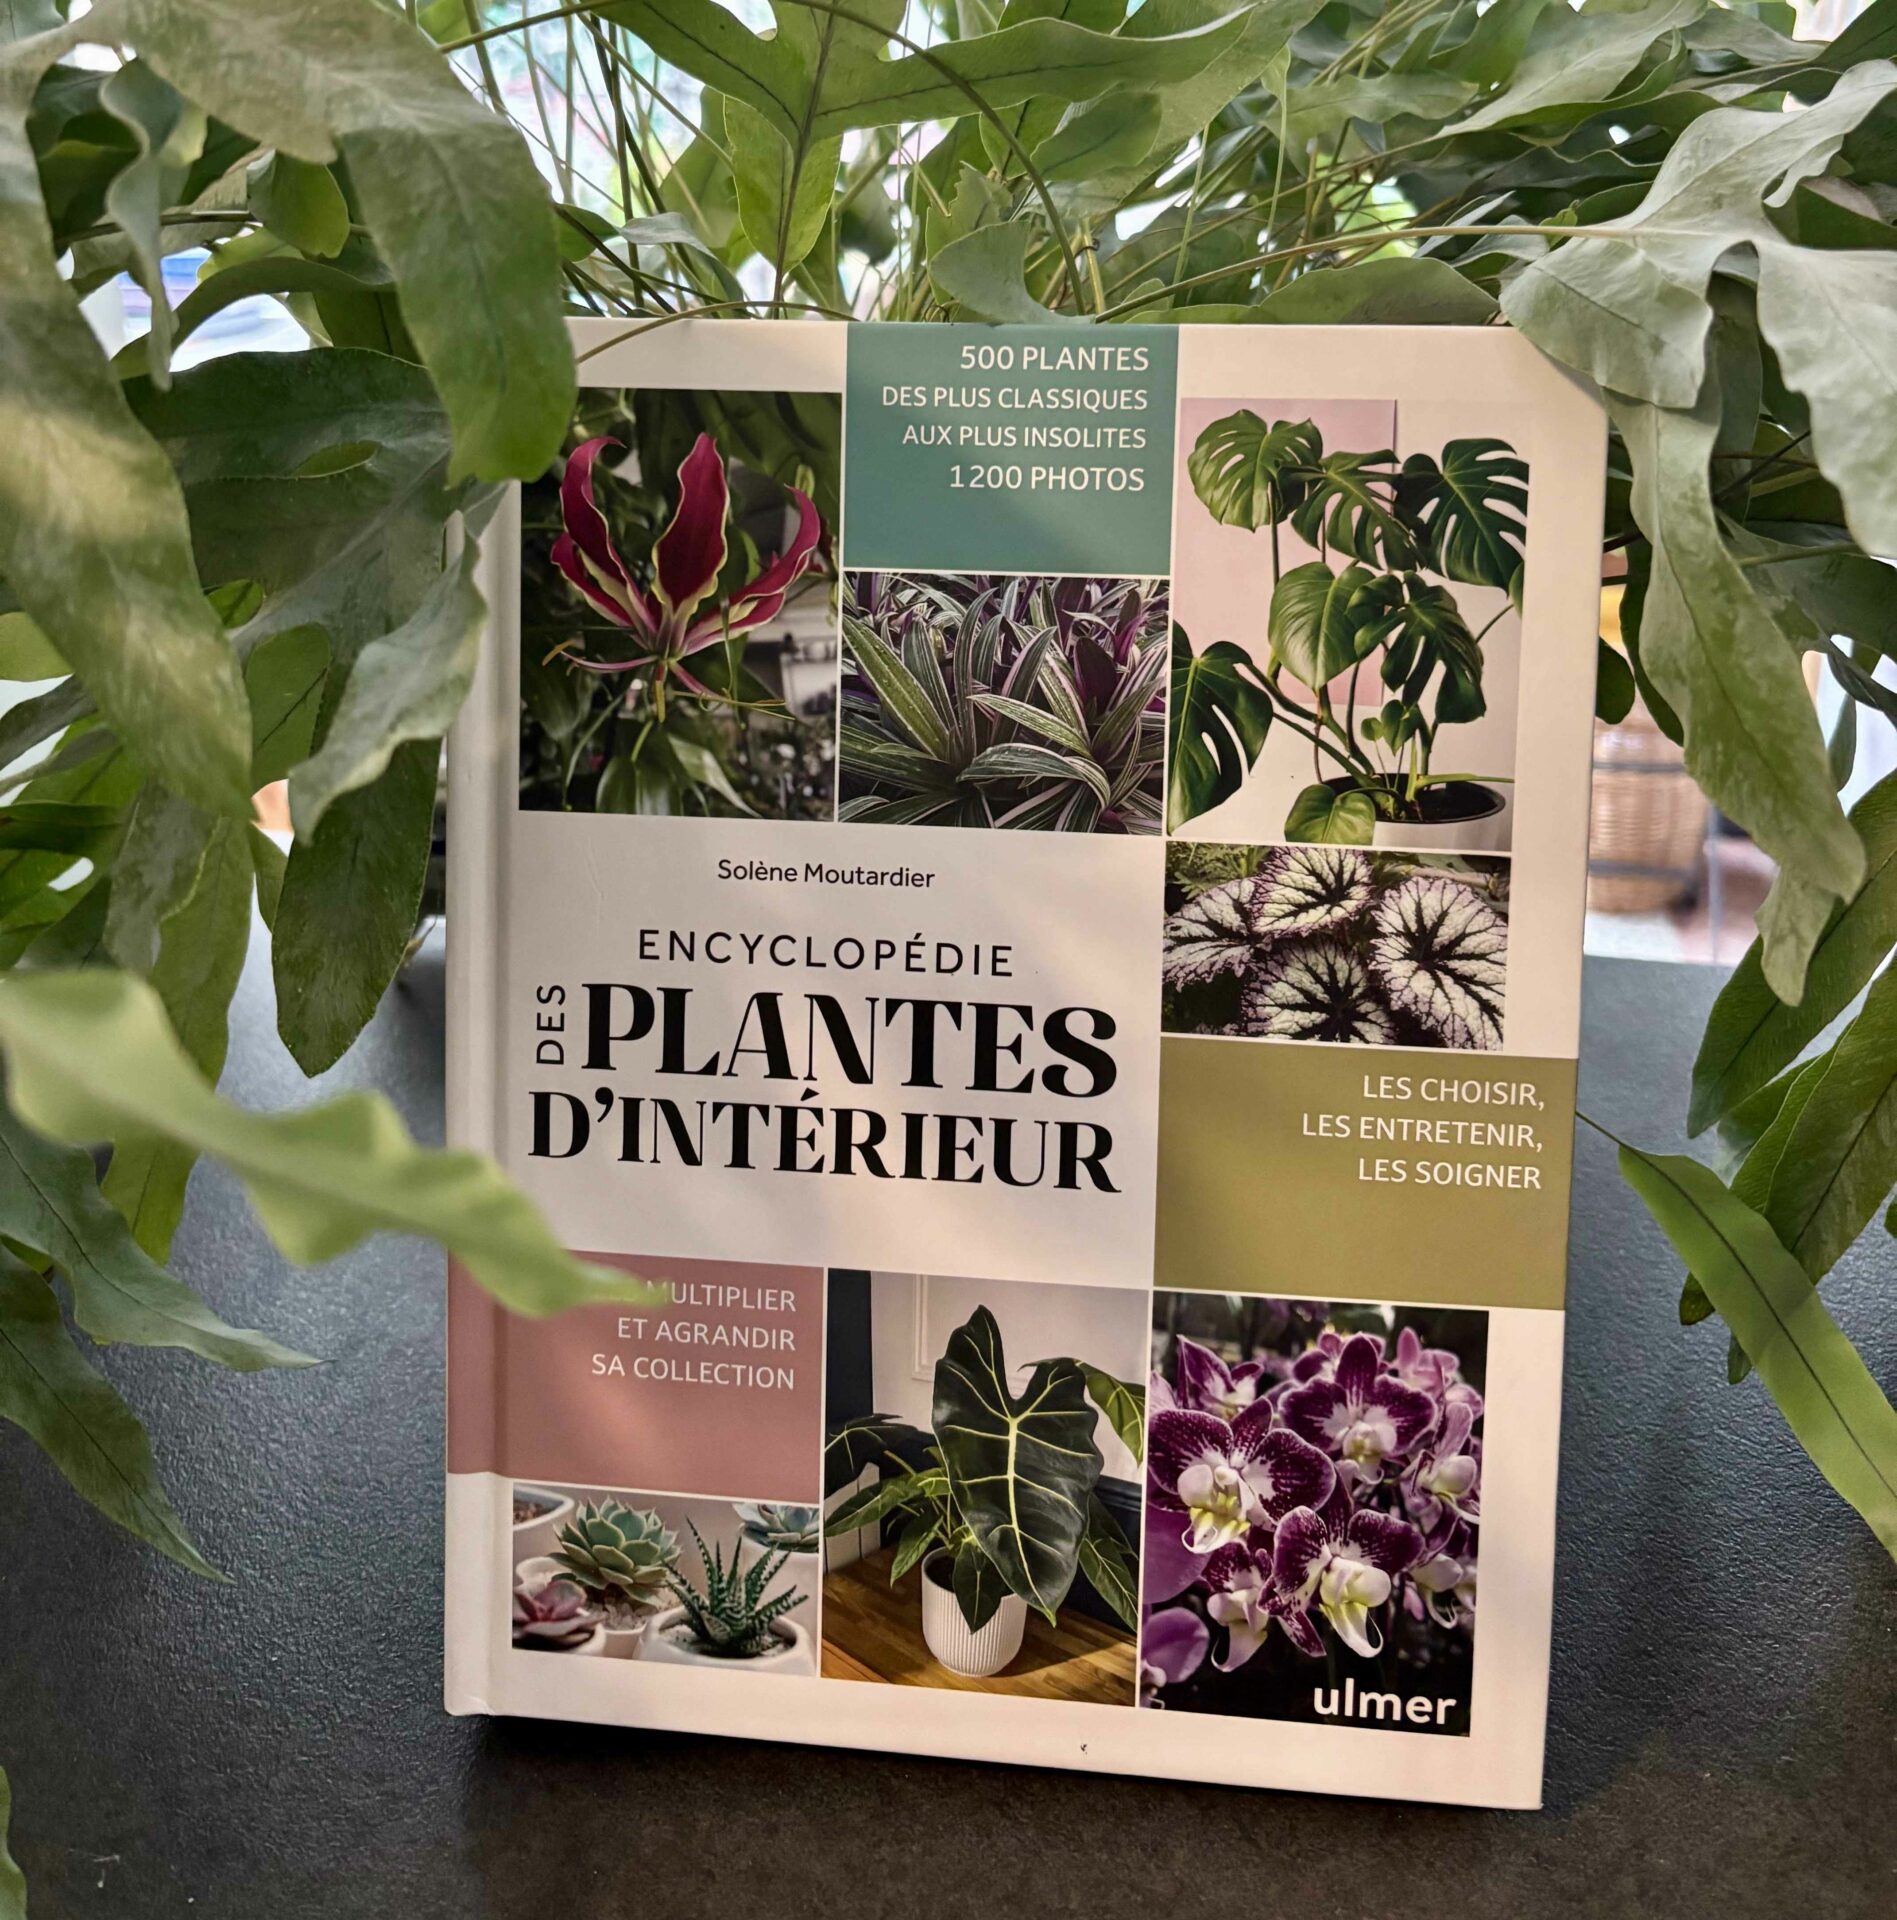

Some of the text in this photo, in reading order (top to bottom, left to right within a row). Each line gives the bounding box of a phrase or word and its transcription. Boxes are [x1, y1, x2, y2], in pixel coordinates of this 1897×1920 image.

[960, 345, 1149, 372] 500 PLANTES
[882, 385, 1148, 413] DES PLUS CLASSIQUES
[901, 424, 1146, 449] AUX PLUS INSOLITES
[1030, 466, 1145, 492] PHOTOS
[717, 859, 936, 889] Solène Moutardier
[638, 929, 1013, 977] ENCYCLOPÉDIE
[536, 983, 566, 1065] DES
[581, 982, 1118, 1098] PLANTES
[1363, 1074, 1545, 1111] LES CHOISIR,
[527, 1086, 1122, 1193] D’INTÉRIEUR
[1302, 1113, 1543, 1152] LES ENTRETENIR,
[1358, 1158, 1541, 1189] LES SOIGNER
[617, 1317, 796, 1351] ET AGRANDIR
[592, 1353, 795, 1390] SA COLLECTION
[1313, 1677, 1457, 1725] ulmer
